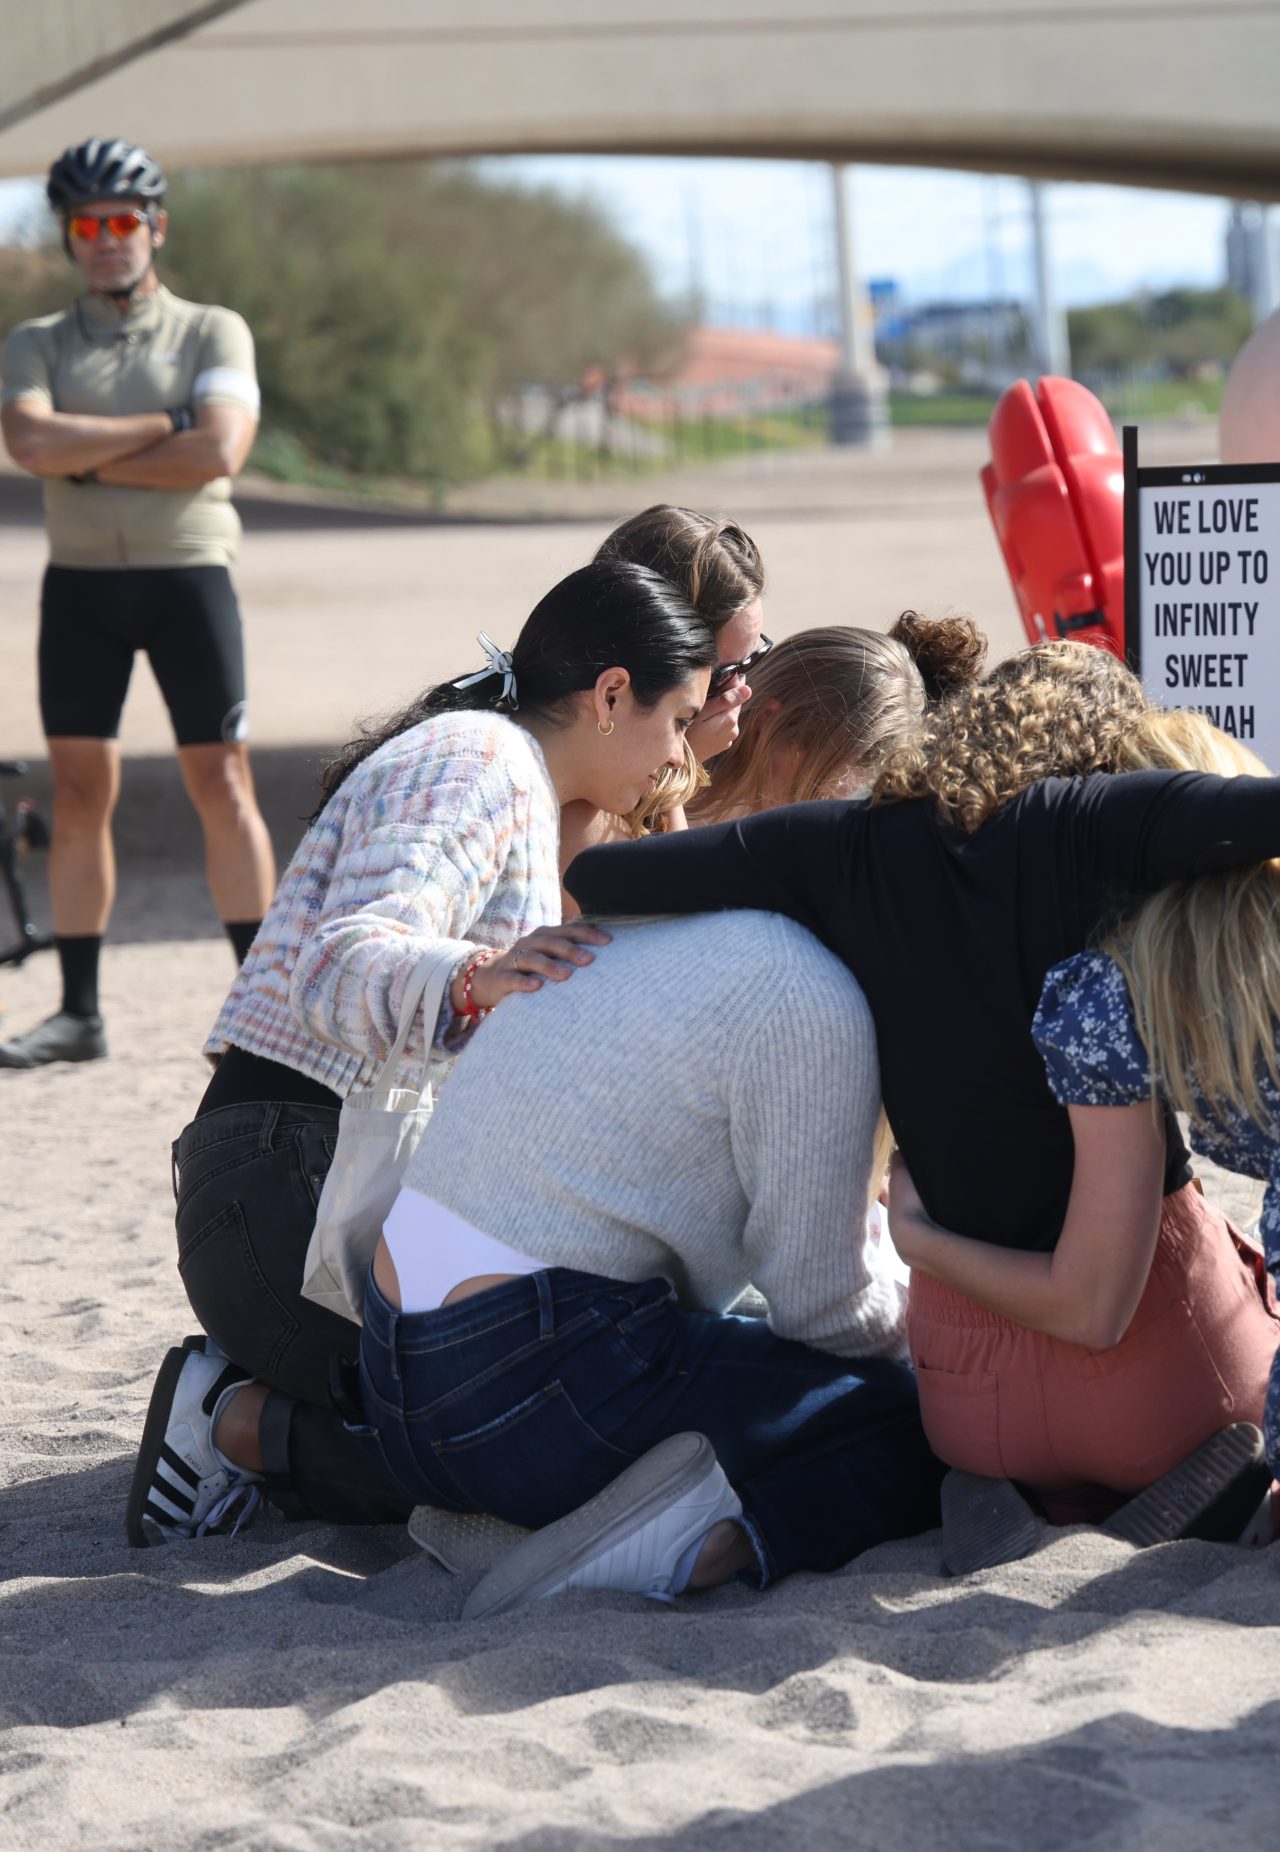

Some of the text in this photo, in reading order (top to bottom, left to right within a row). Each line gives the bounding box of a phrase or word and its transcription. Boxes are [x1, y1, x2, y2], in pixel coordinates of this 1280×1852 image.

[1154, 498, 1259, 534] WE LOVE
[1144, 549, 1268, 586] YOU UP TO
[1155, 602, 1259, 637] INFINITY
[1165, 654, 1248, 688] SWEET
